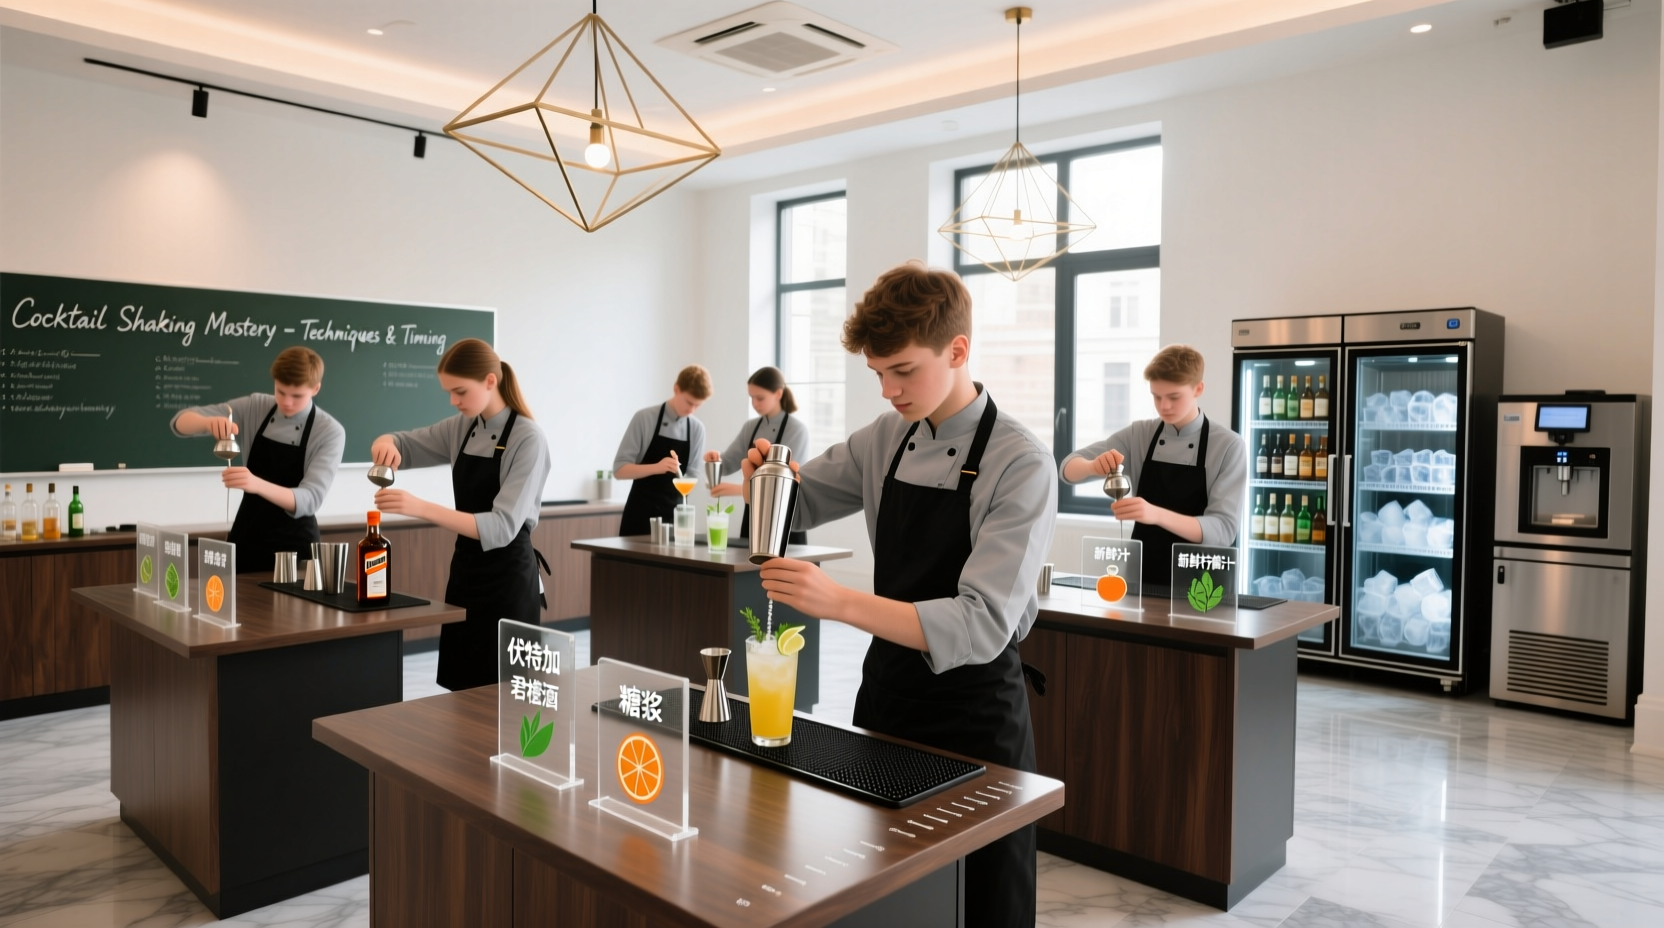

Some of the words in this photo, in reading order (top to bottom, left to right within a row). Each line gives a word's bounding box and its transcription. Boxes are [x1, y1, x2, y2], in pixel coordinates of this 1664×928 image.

[11, 296, 108, 330] Cocktail
[116, 304, 196, 347] Shaking
[204, 310, 277, 347] Mastery
[300, 318, 380, 353] Techniques
[385, 325, 397, 345] &
[400, 324, 447, 356] Timing
[506, 636, 561, 676] 伏特加
[618, 684, 663, 723] 糖浆
